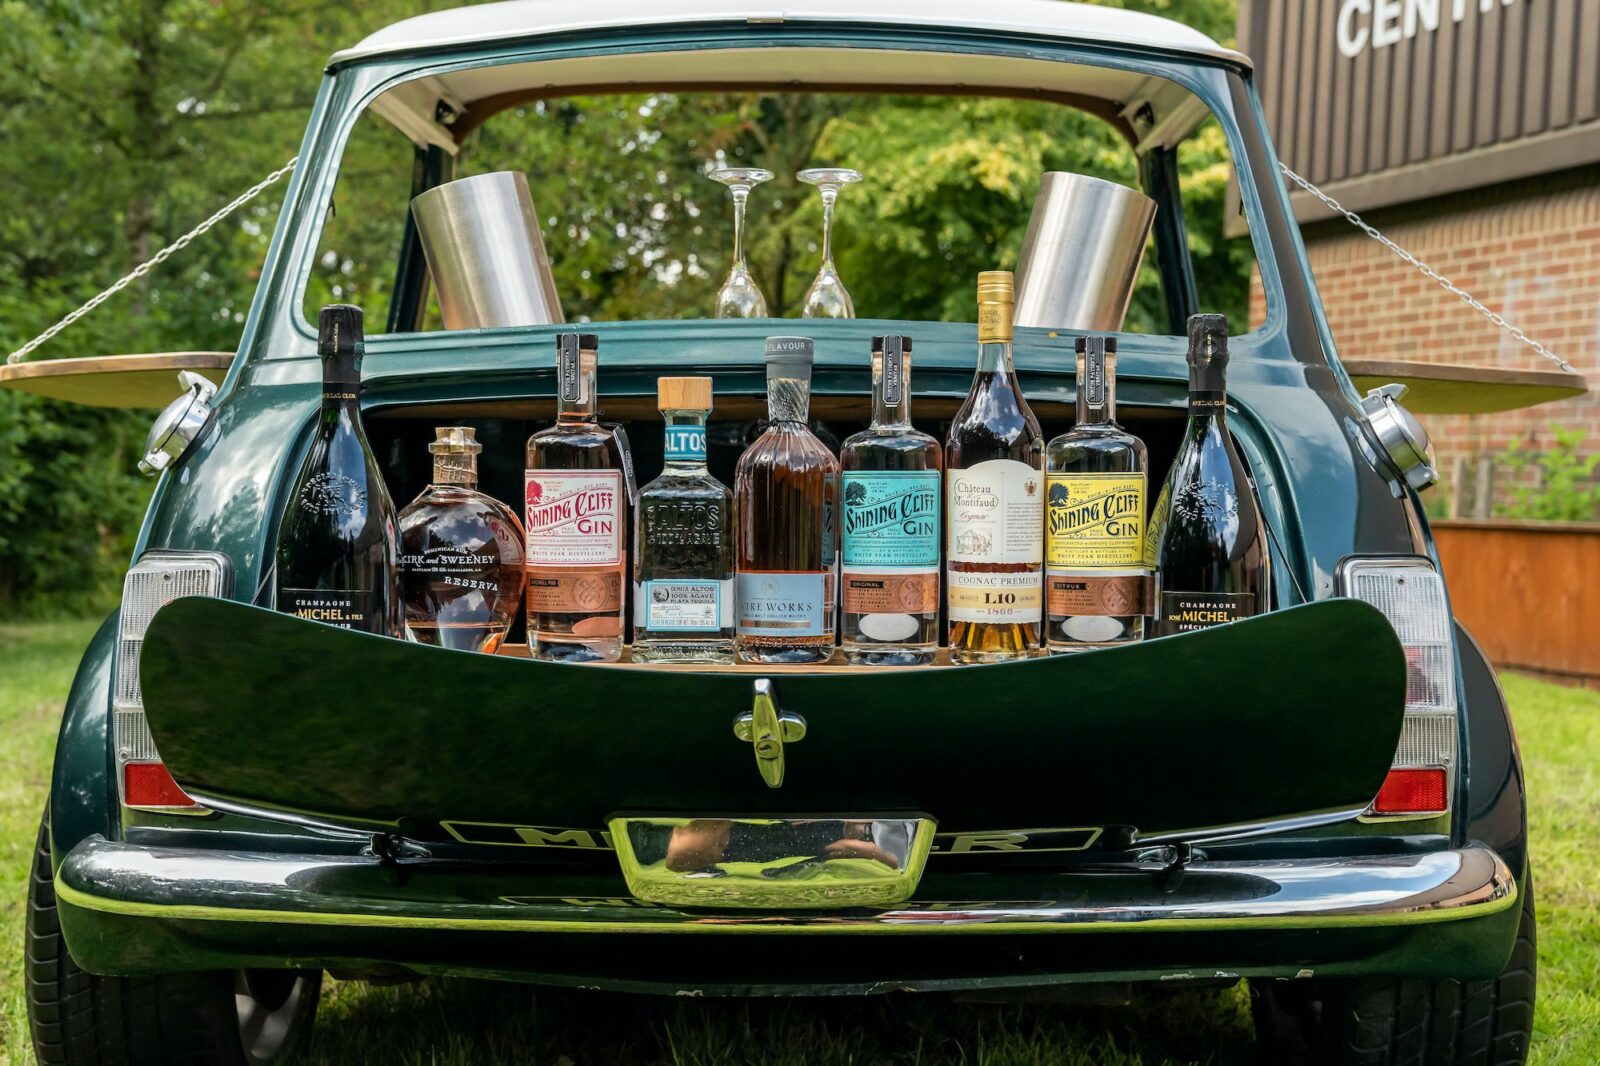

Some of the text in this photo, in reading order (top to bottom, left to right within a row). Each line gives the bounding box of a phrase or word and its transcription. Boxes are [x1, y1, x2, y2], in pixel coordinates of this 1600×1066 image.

[665, 432, 706, 452] ALTOS
[578, 519, 612, 534] GIN
[903, 520, 933, 535] GIN
[1106, 521, 1138, 536] GIN
[401, 555, 426, 567] KIRK
[439, 554, 495, 564] SWEENEY
[444, 576, 498, 591] RESERVA
[958, 576, 1038, 585] COGNAC PREMIUM
[295, 599, 351, 607] CHAMPAGNE
[766, 602, 812, 612] WORKS
[298, 608, 344, 620] MICHEL
[1182, 610, 1230, 622] MICHEL
